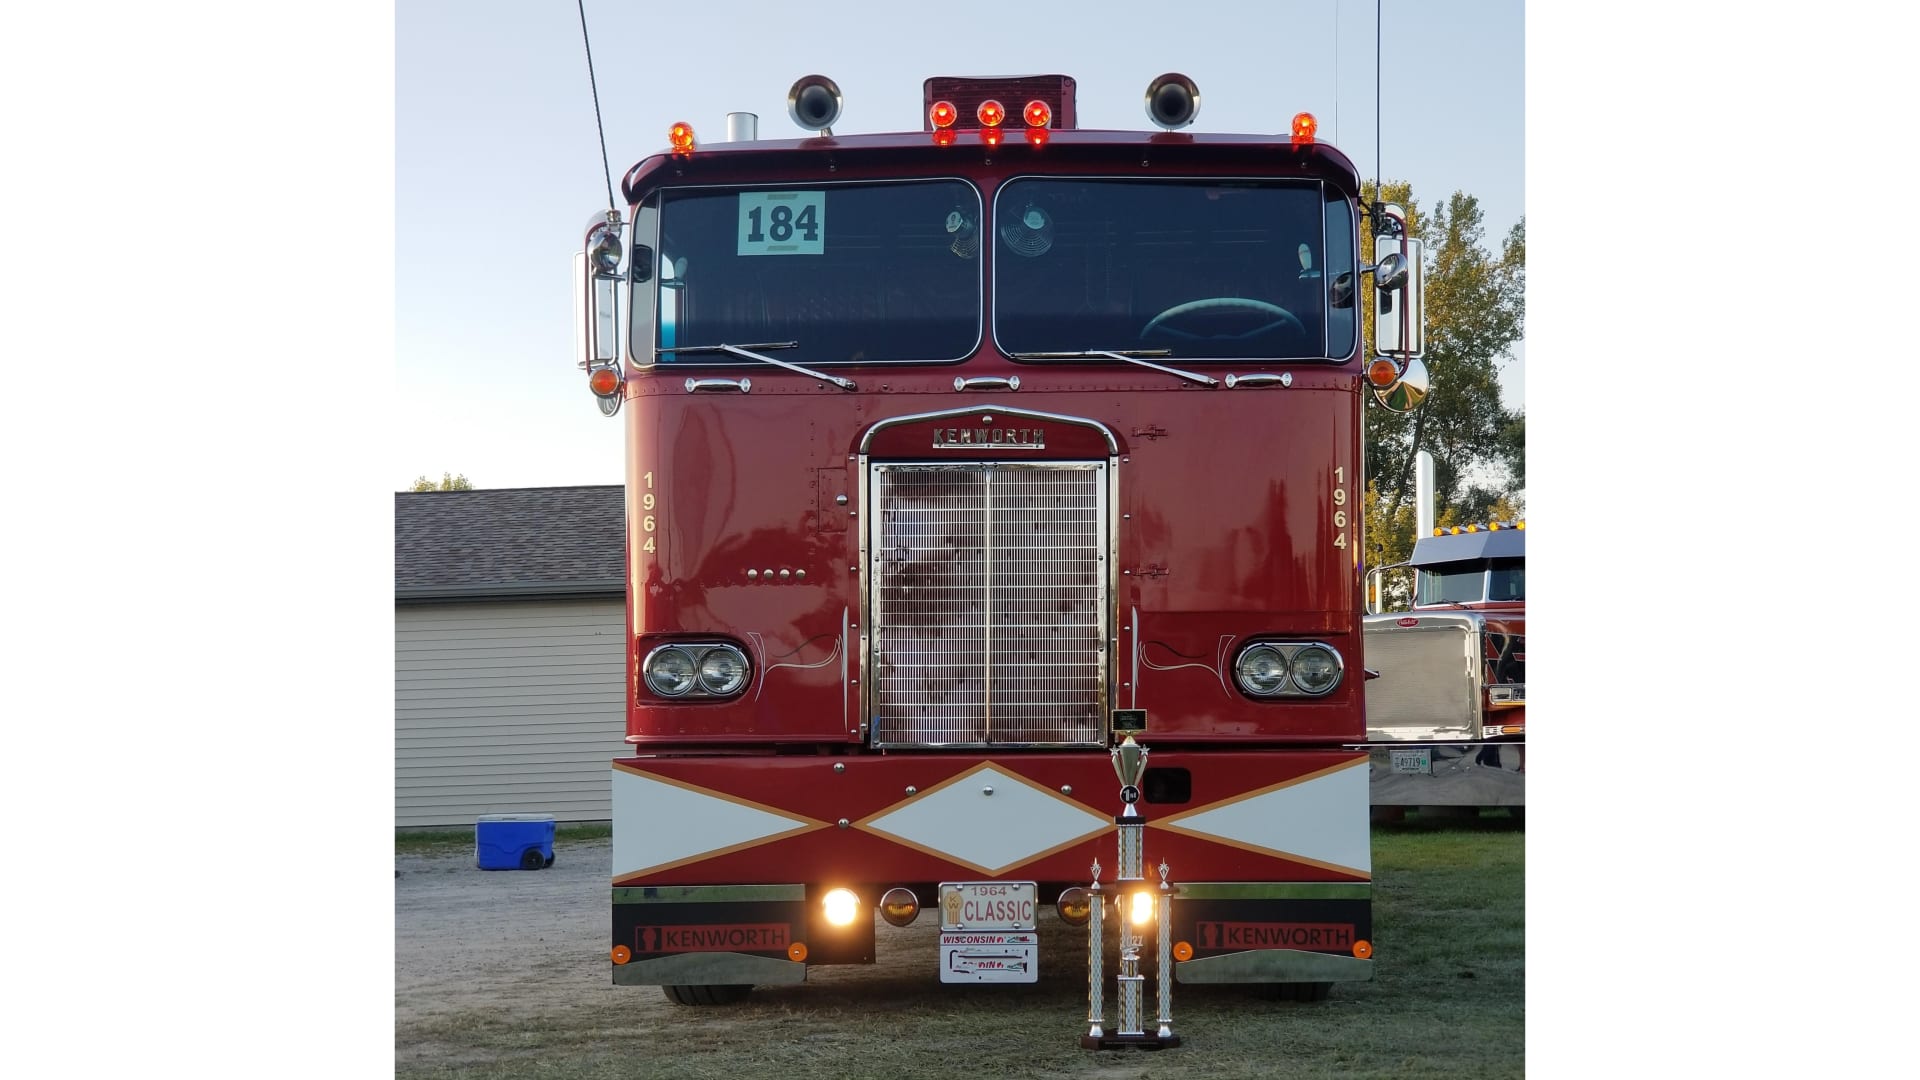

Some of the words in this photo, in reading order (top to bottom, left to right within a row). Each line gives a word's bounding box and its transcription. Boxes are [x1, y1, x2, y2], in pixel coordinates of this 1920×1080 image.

[748, 205, 819, 242] 184
[933, 428, 1044, 444] KENWORTH
[642, 471, 656, 554] 1964
[1333, 466, 1347, 550] 1964
[971, 886, 1008, 897] 1964
[964, 900, 1032, 922] CLASSIC
[666, 928, 785, 947] KENWORTH
[943, 935, 996, 944] WISCONSIN
[1228, 927, 1350, 946] KENWORTH
